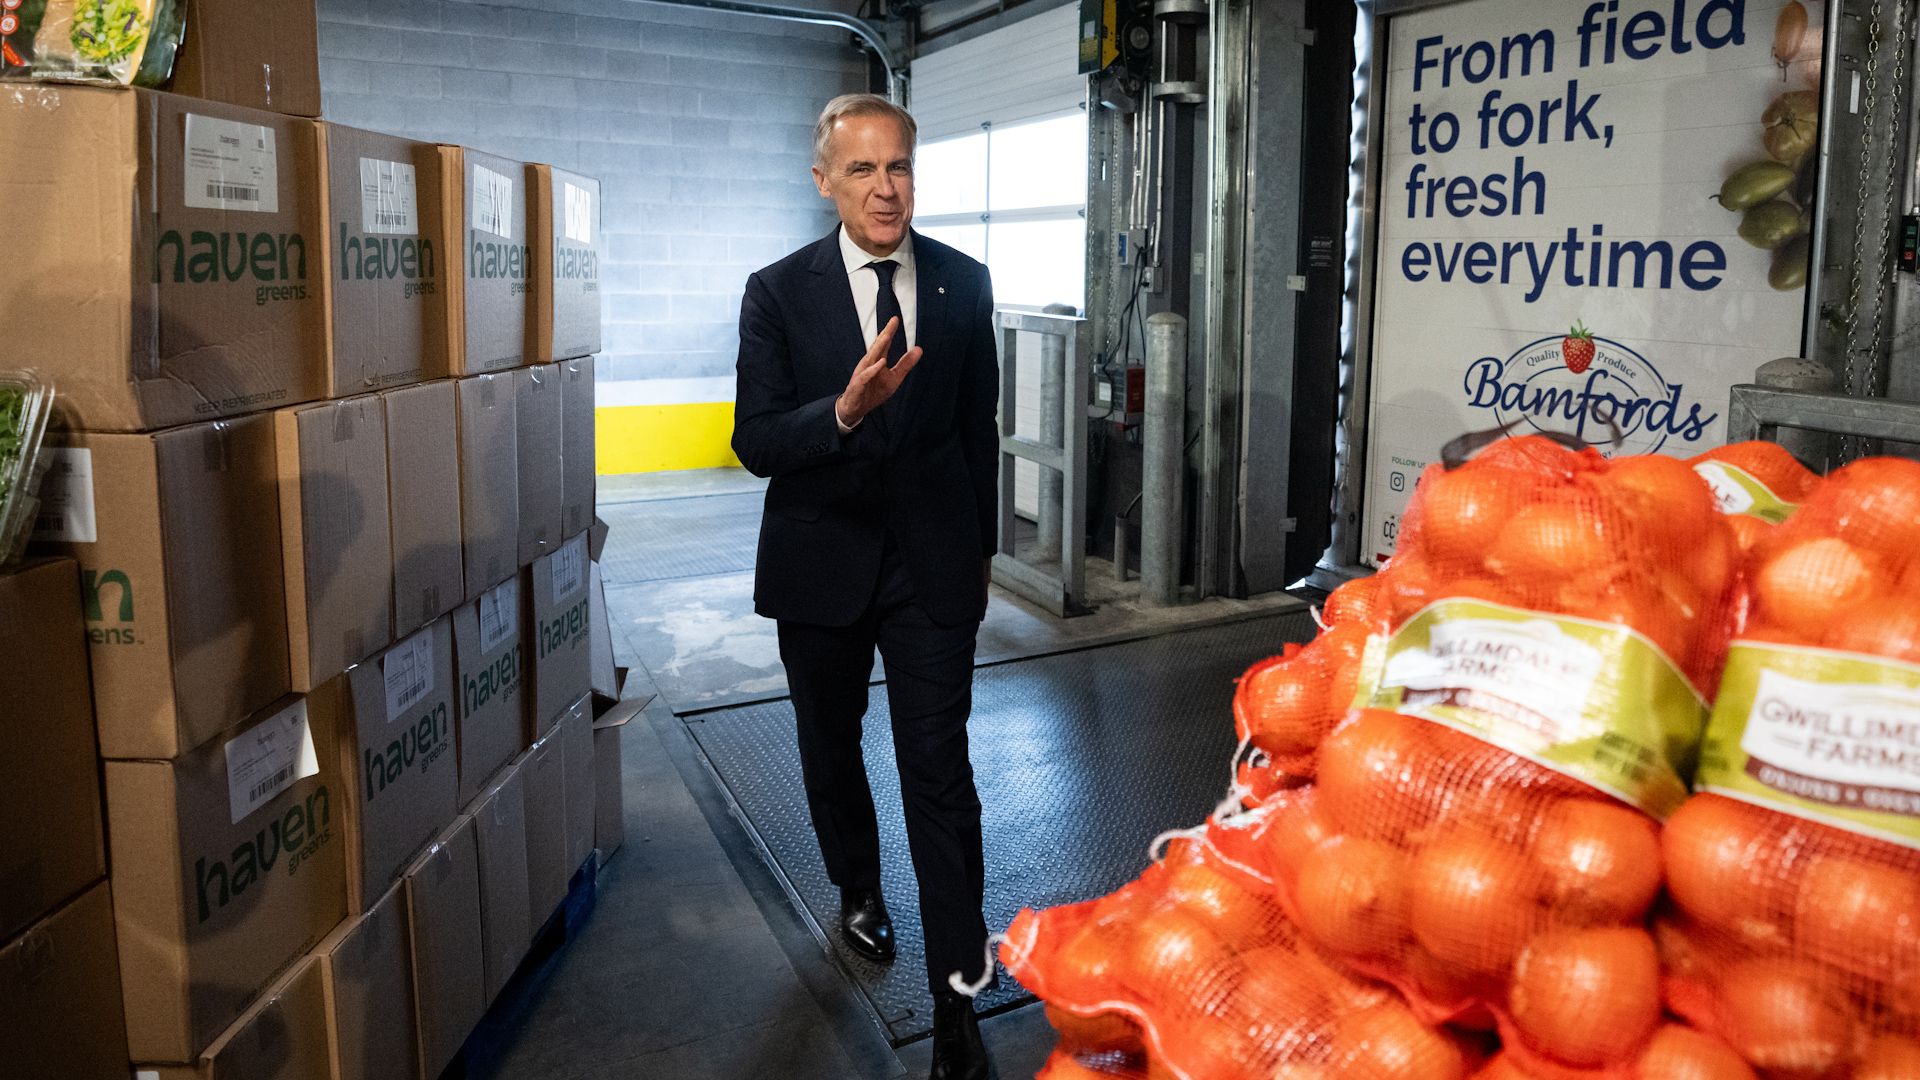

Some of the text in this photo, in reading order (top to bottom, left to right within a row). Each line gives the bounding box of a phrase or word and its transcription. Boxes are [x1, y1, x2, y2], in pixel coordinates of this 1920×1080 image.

[1413, 0, 1746, 92] From field
[1409, 79, 1614, 155] to fork,
[1405, 156, 1546, 219] fresh
[340, 222, 435, 280] haven
[470, 229, 532, 279] haven
[555, 236, 598, 280] haven
[1401, 224, 1727, 304] everytime
[256, 284, 307, 306] greens
[404, 282, 435, 299] greens
[511, 281, 532, 296] greens
[381, 367, 423, 384] REFRIGERATED
[1526, 349, 1637, 379] Quality Produce
[194, 389, 287, 414] KEEP REFRIGERATED
[1464, 357, 1718, 442] Bamfords
[1391, 456, 1417, 467] FOLLOW
[88, 628, 135, 645] ens
[539, 597, 588, 660] haven
[463, 642, 522, 719] haven
[364, 701, 448, 802] haven
[421, 738, 448, 774] greens
[194, 785, 330, 924] haven
[288, 828, 331, 877] greens
